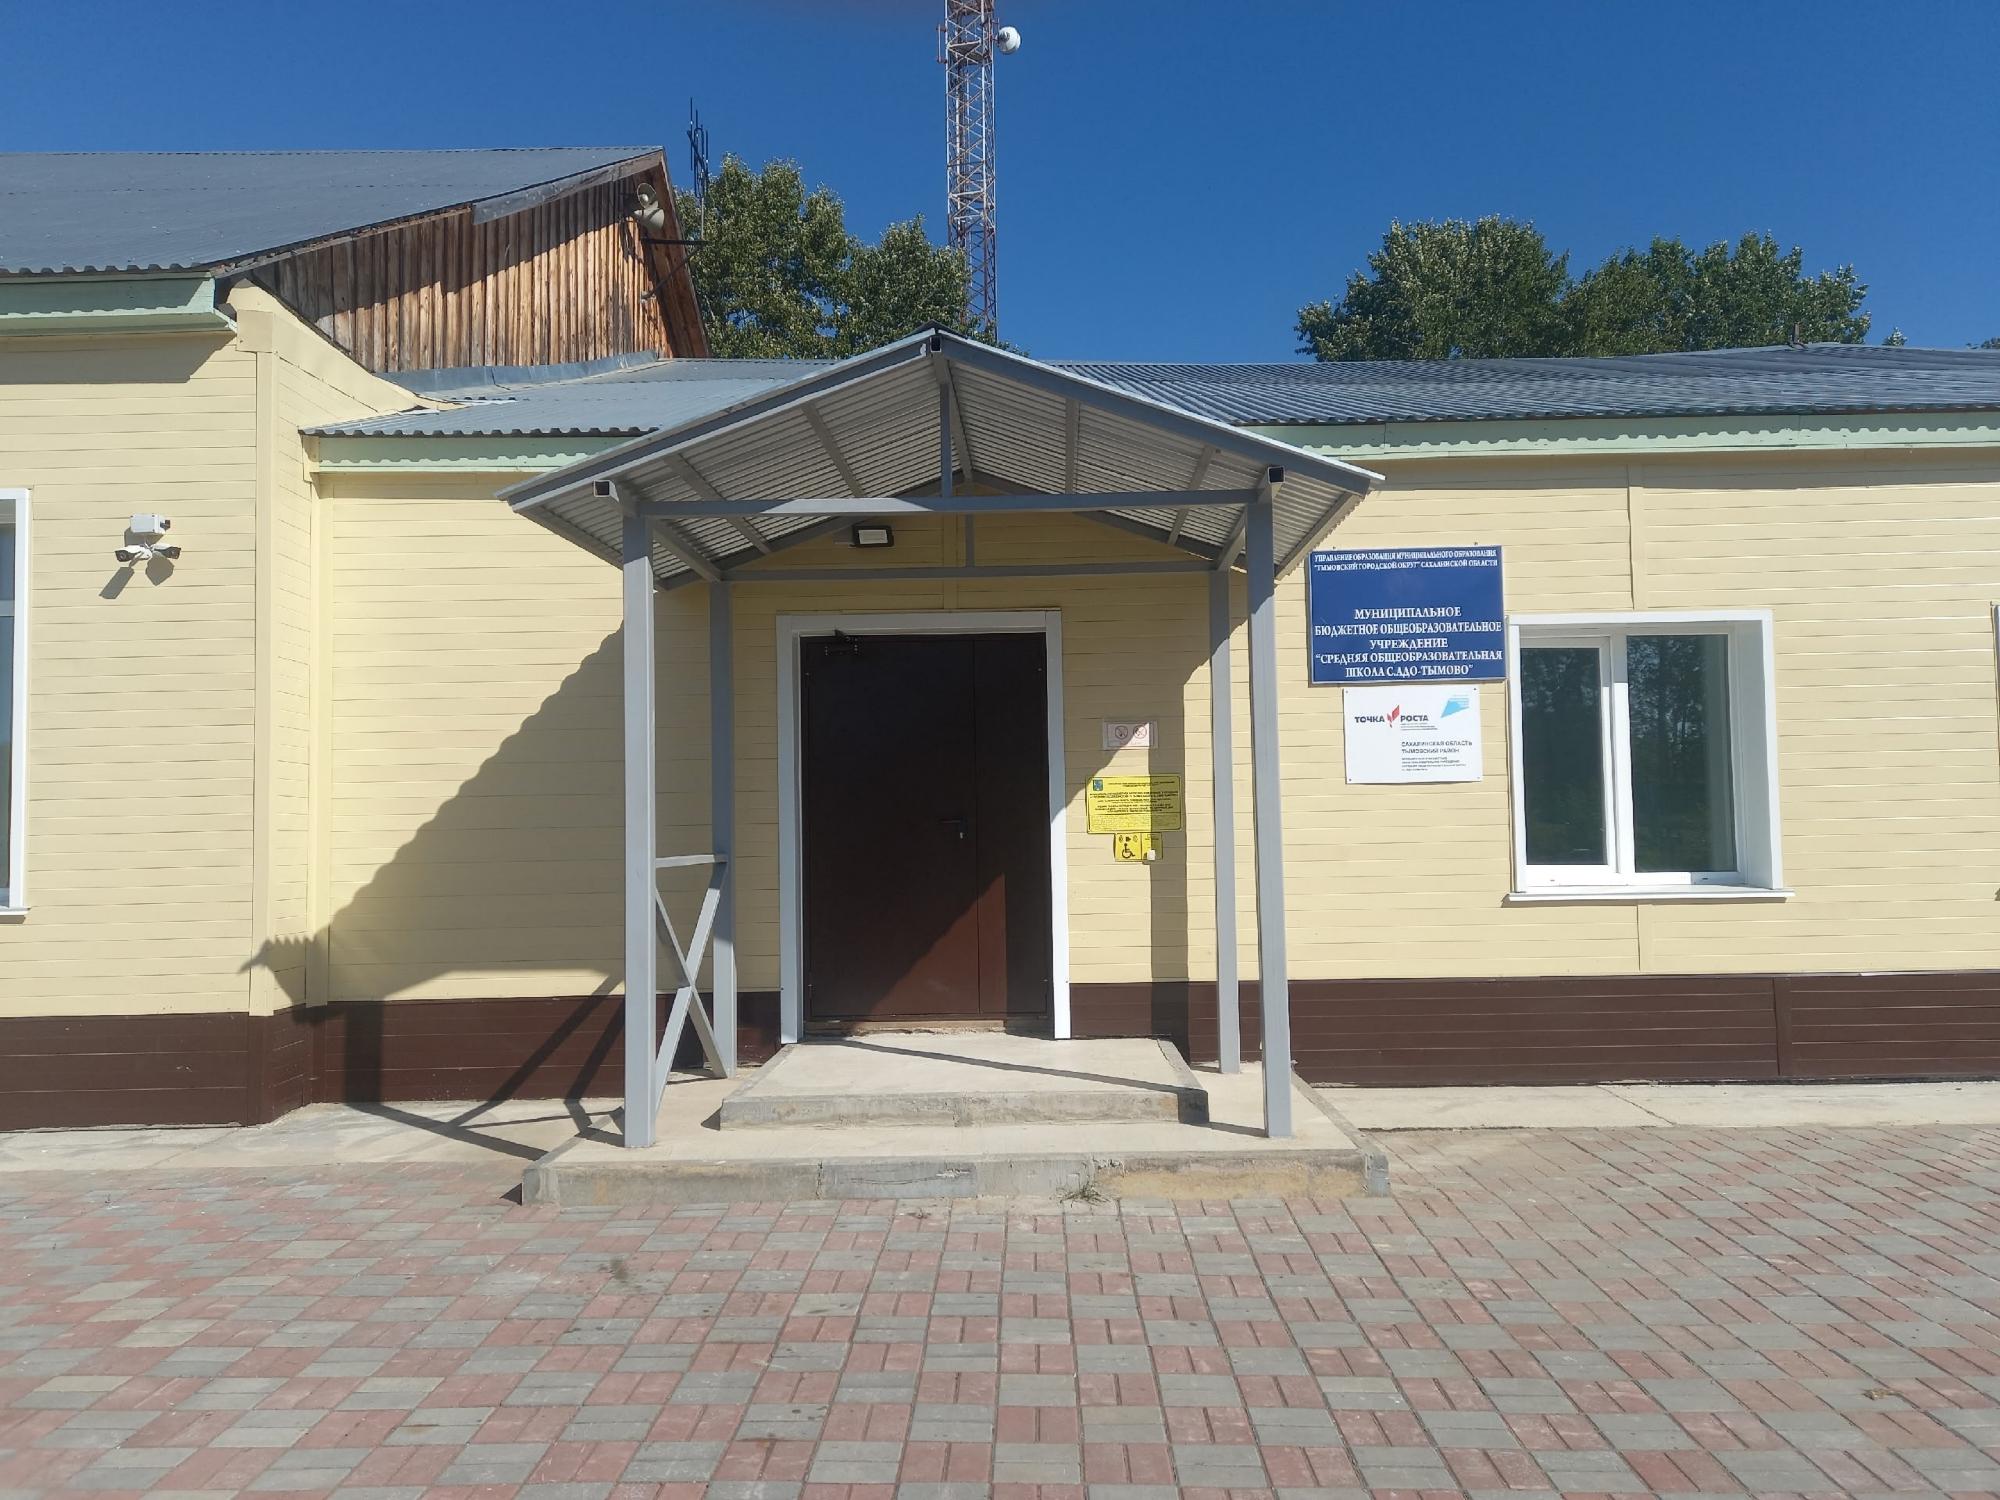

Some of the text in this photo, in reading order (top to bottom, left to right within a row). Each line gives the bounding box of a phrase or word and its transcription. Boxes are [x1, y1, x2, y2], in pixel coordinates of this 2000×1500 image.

[1353, 552, 1396, 561] ОБРАЗОВАНИЯ
[1469, 559, 1497, 567] ОБЛАСТИ
[1354, 607, 1461, 620] МУНИЦИПАЛЬНОЕ
[1315, 622, 1501, 637] БЮДЖЕТНОЕ ОБЩЕОБРАЗОВАТЕЛЬНОЕ
[1370, 638, 1448, 649] УЧРЕЖДЕНИЕ
[1370, 650, 1502, 663] ОБЩЕОБРАЗОВАТЕЛЬНАЯ
[1345, 667, 1386, 677] ШКОЛА
